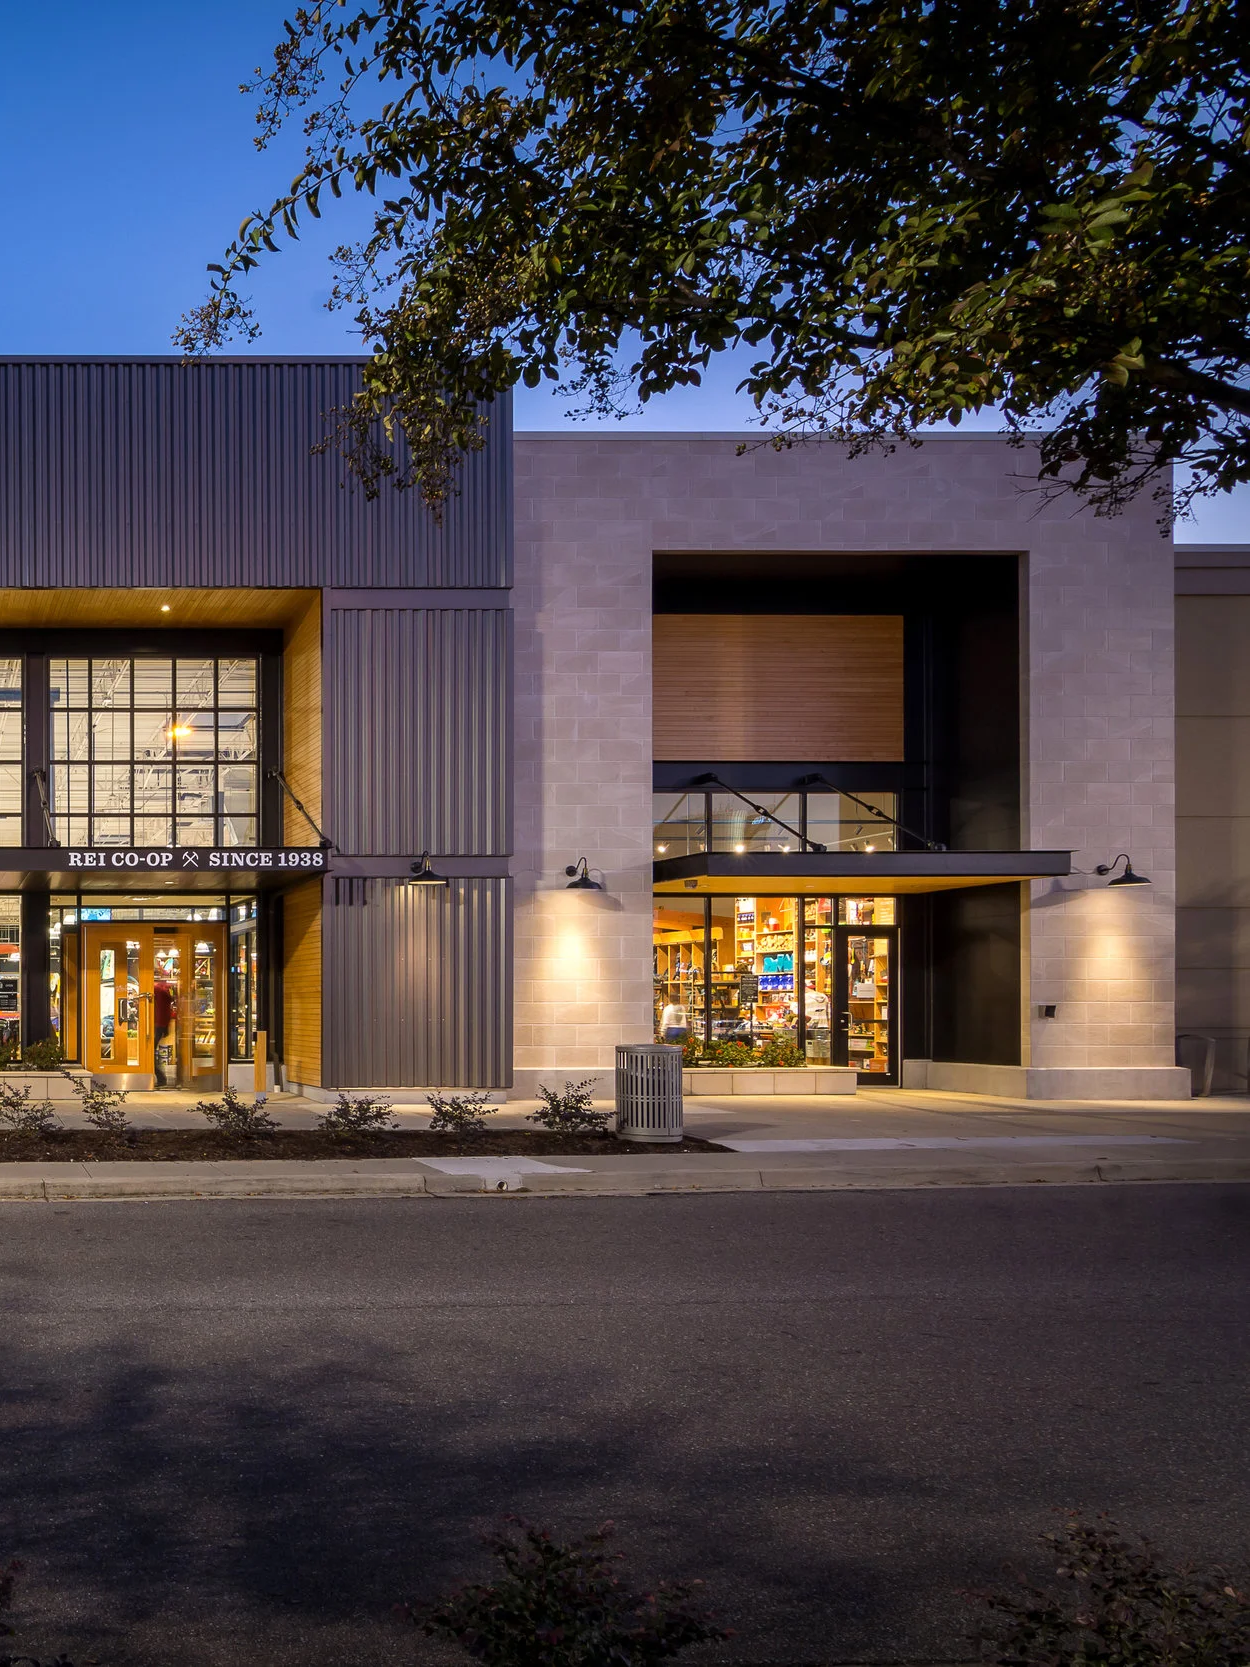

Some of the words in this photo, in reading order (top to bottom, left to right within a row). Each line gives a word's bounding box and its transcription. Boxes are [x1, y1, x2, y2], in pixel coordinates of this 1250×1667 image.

[68, 851, 106, 867] REI
[111, 851, 173, 867] CO-OP
[209, 851, 273, 867] SINCE
[277, 851, 323, 867] 1938
